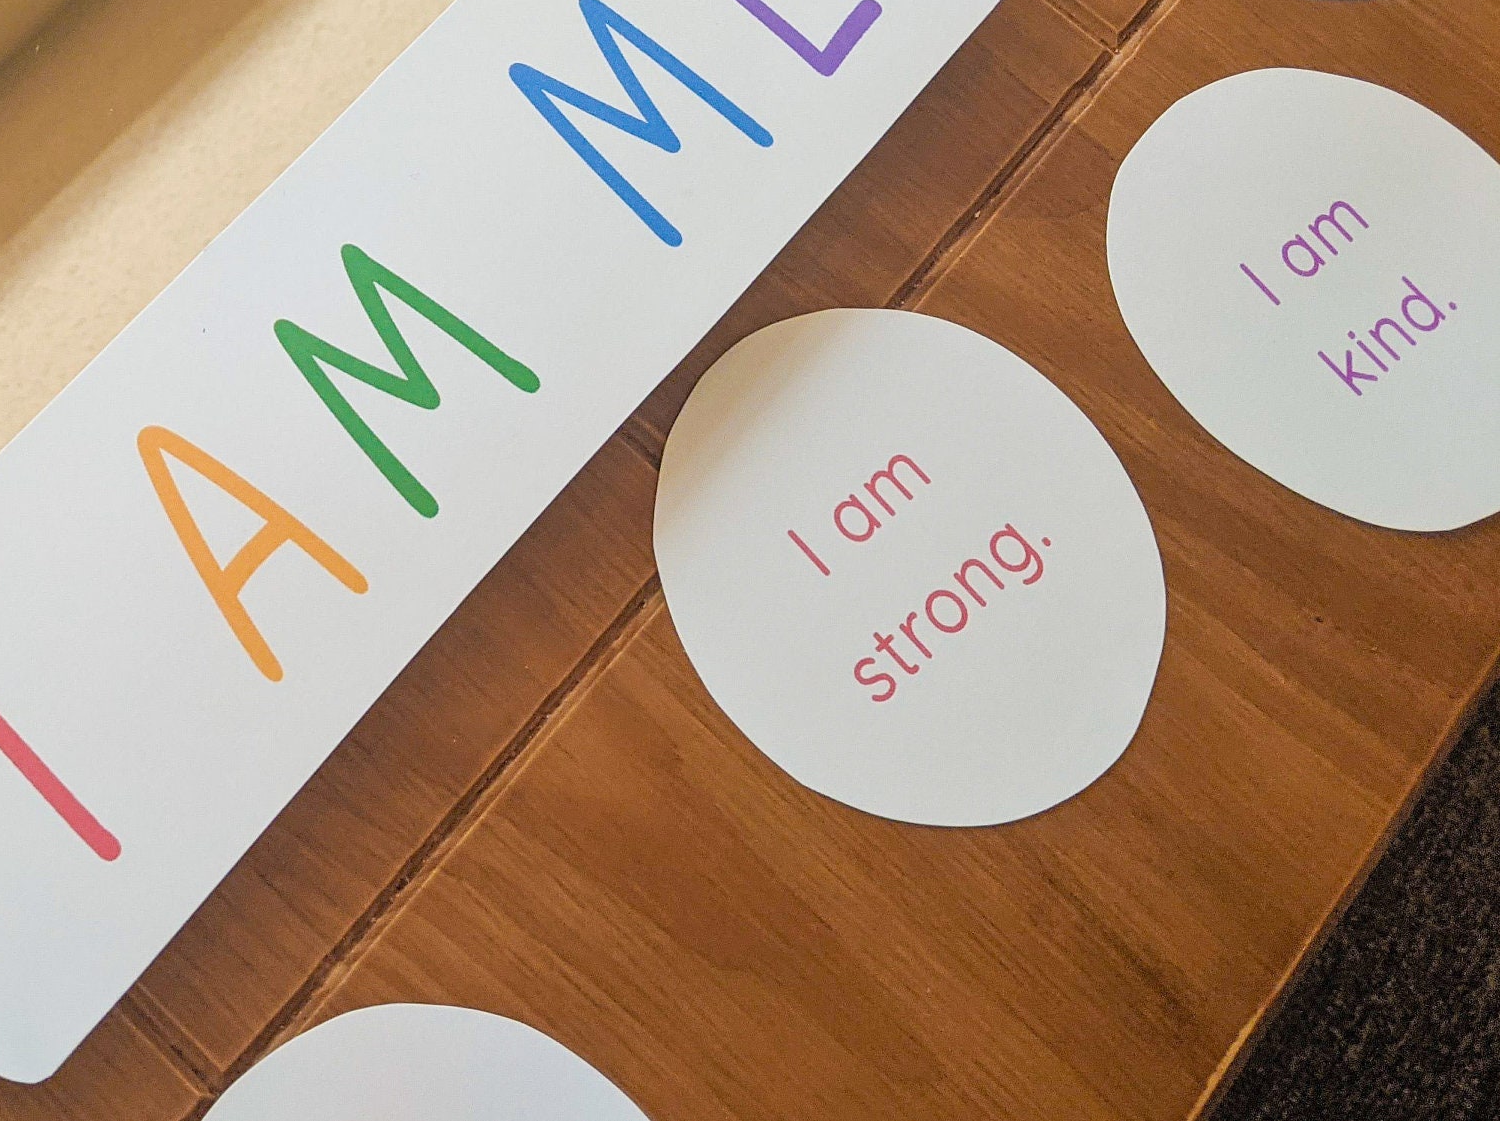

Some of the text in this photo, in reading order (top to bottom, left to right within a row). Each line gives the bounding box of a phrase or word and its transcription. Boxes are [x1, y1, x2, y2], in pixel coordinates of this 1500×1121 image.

[1237, 199, 1371, 308] I am
[1315, 275, 1460, 399] kind.
[135, 241, 543, 684] AM
[786, 452, 933, 578] I am
[850, 520, 1055, 704] strong.
